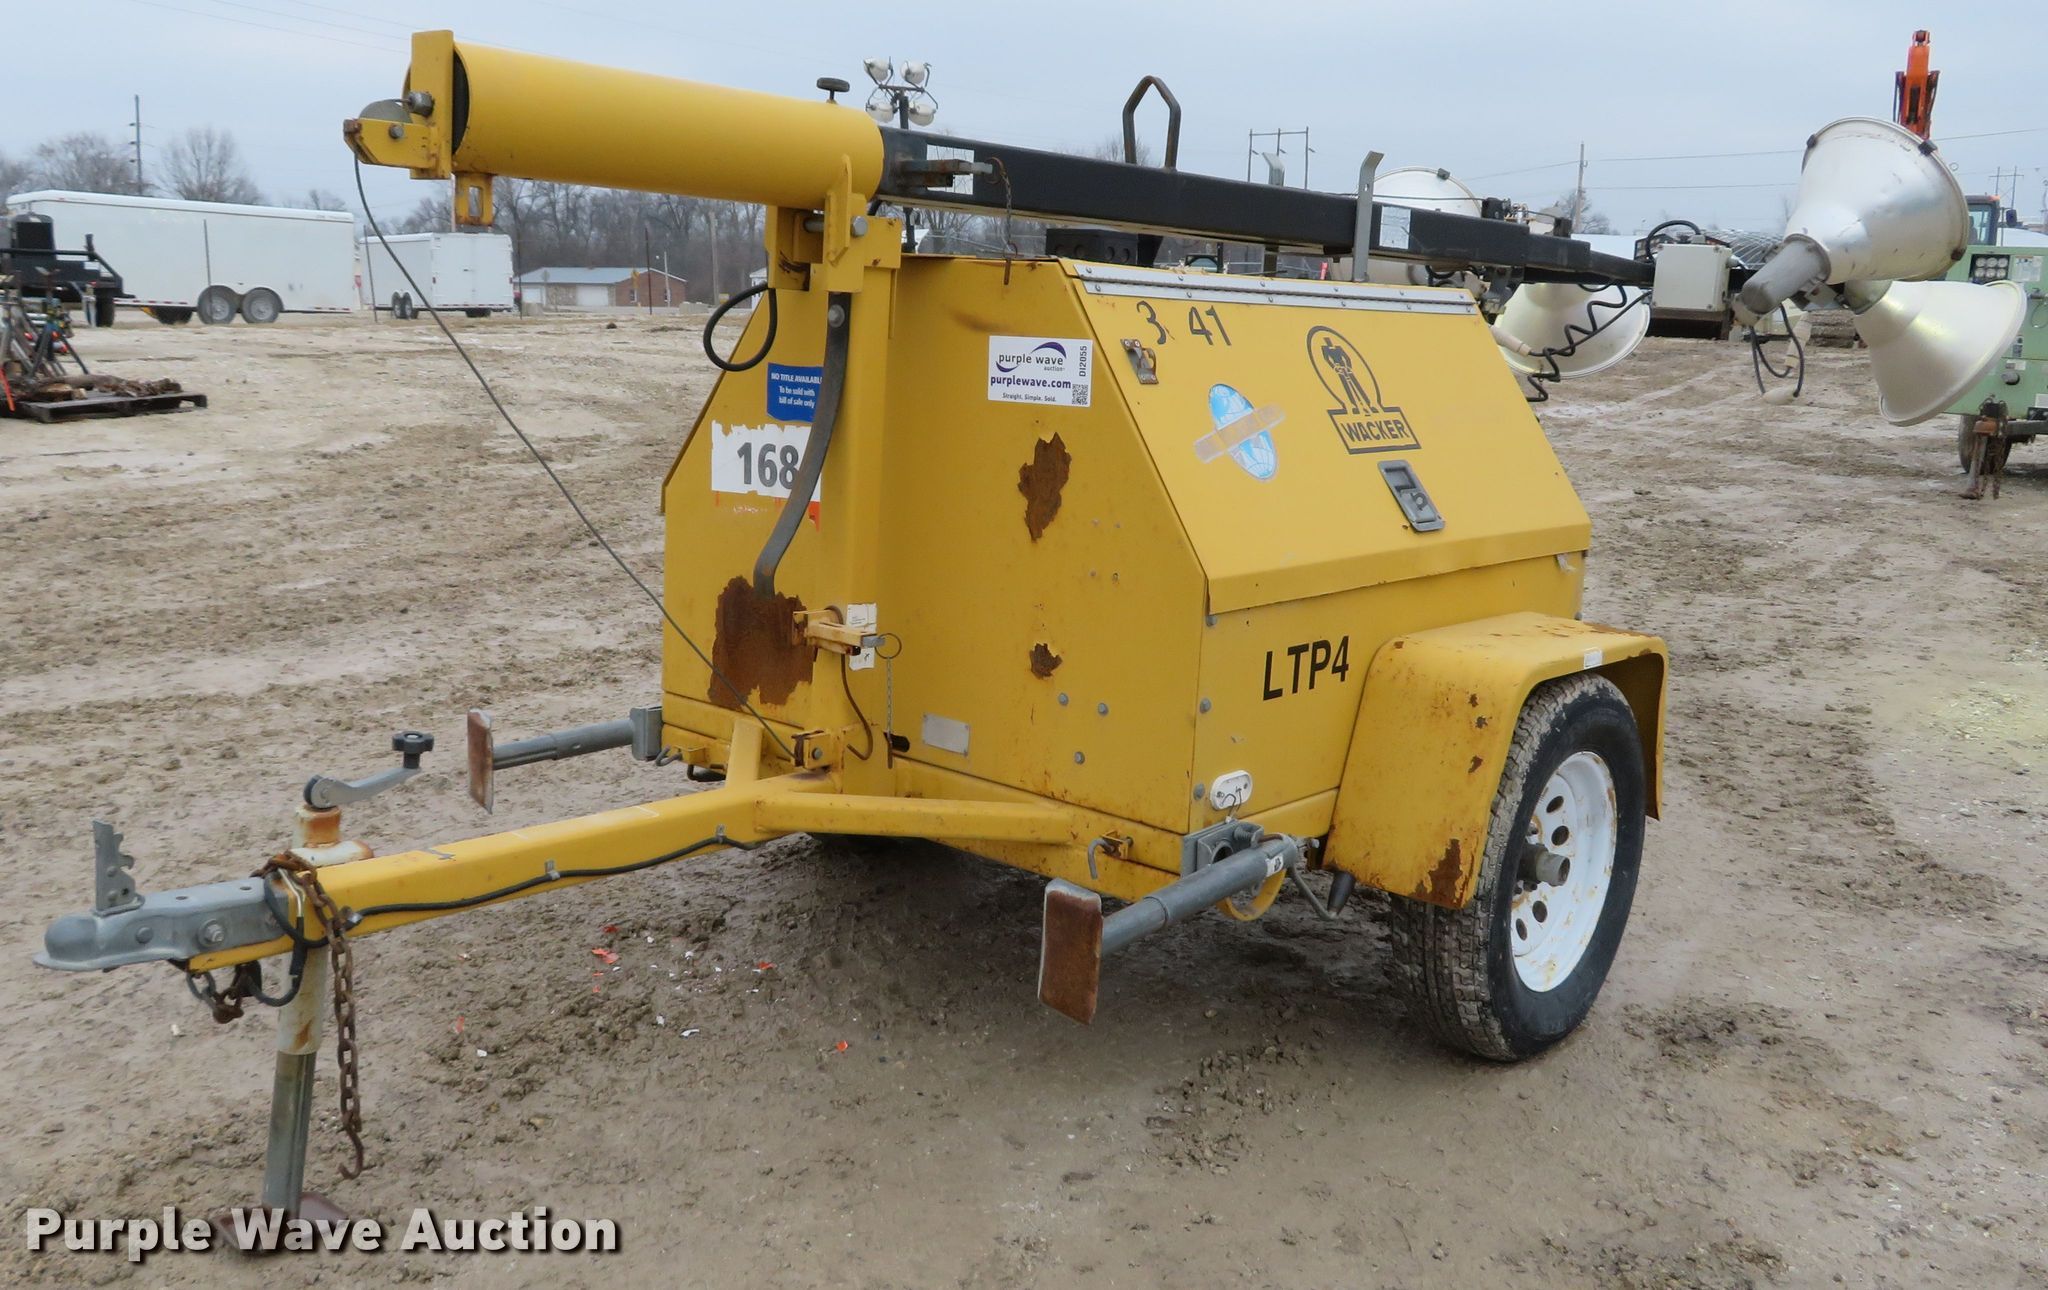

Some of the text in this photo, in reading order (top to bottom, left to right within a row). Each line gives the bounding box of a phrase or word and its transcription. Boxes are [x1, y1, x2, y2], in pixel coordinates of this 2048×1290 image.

[1188, 305, 1231, 346] 41
[999, 354, 1063, 365] purple wave
[1079, 346, 1087, 376] DI2055
[781, 374, 794, 382] TITLE
[990, 375, 1071, 389] purplewave.com
[786, 386, 792, 394] be
[793, 387, 803, 395] sold
[804, 388, 815, 396] with
[794, 398, 803, 406] sale
[804, 399, 815, 408] only
[1341, 419, 1409, 442] WACKER
[737, 442, 799, 489] 168
[1263, 635, 1349, 701] LTP4
